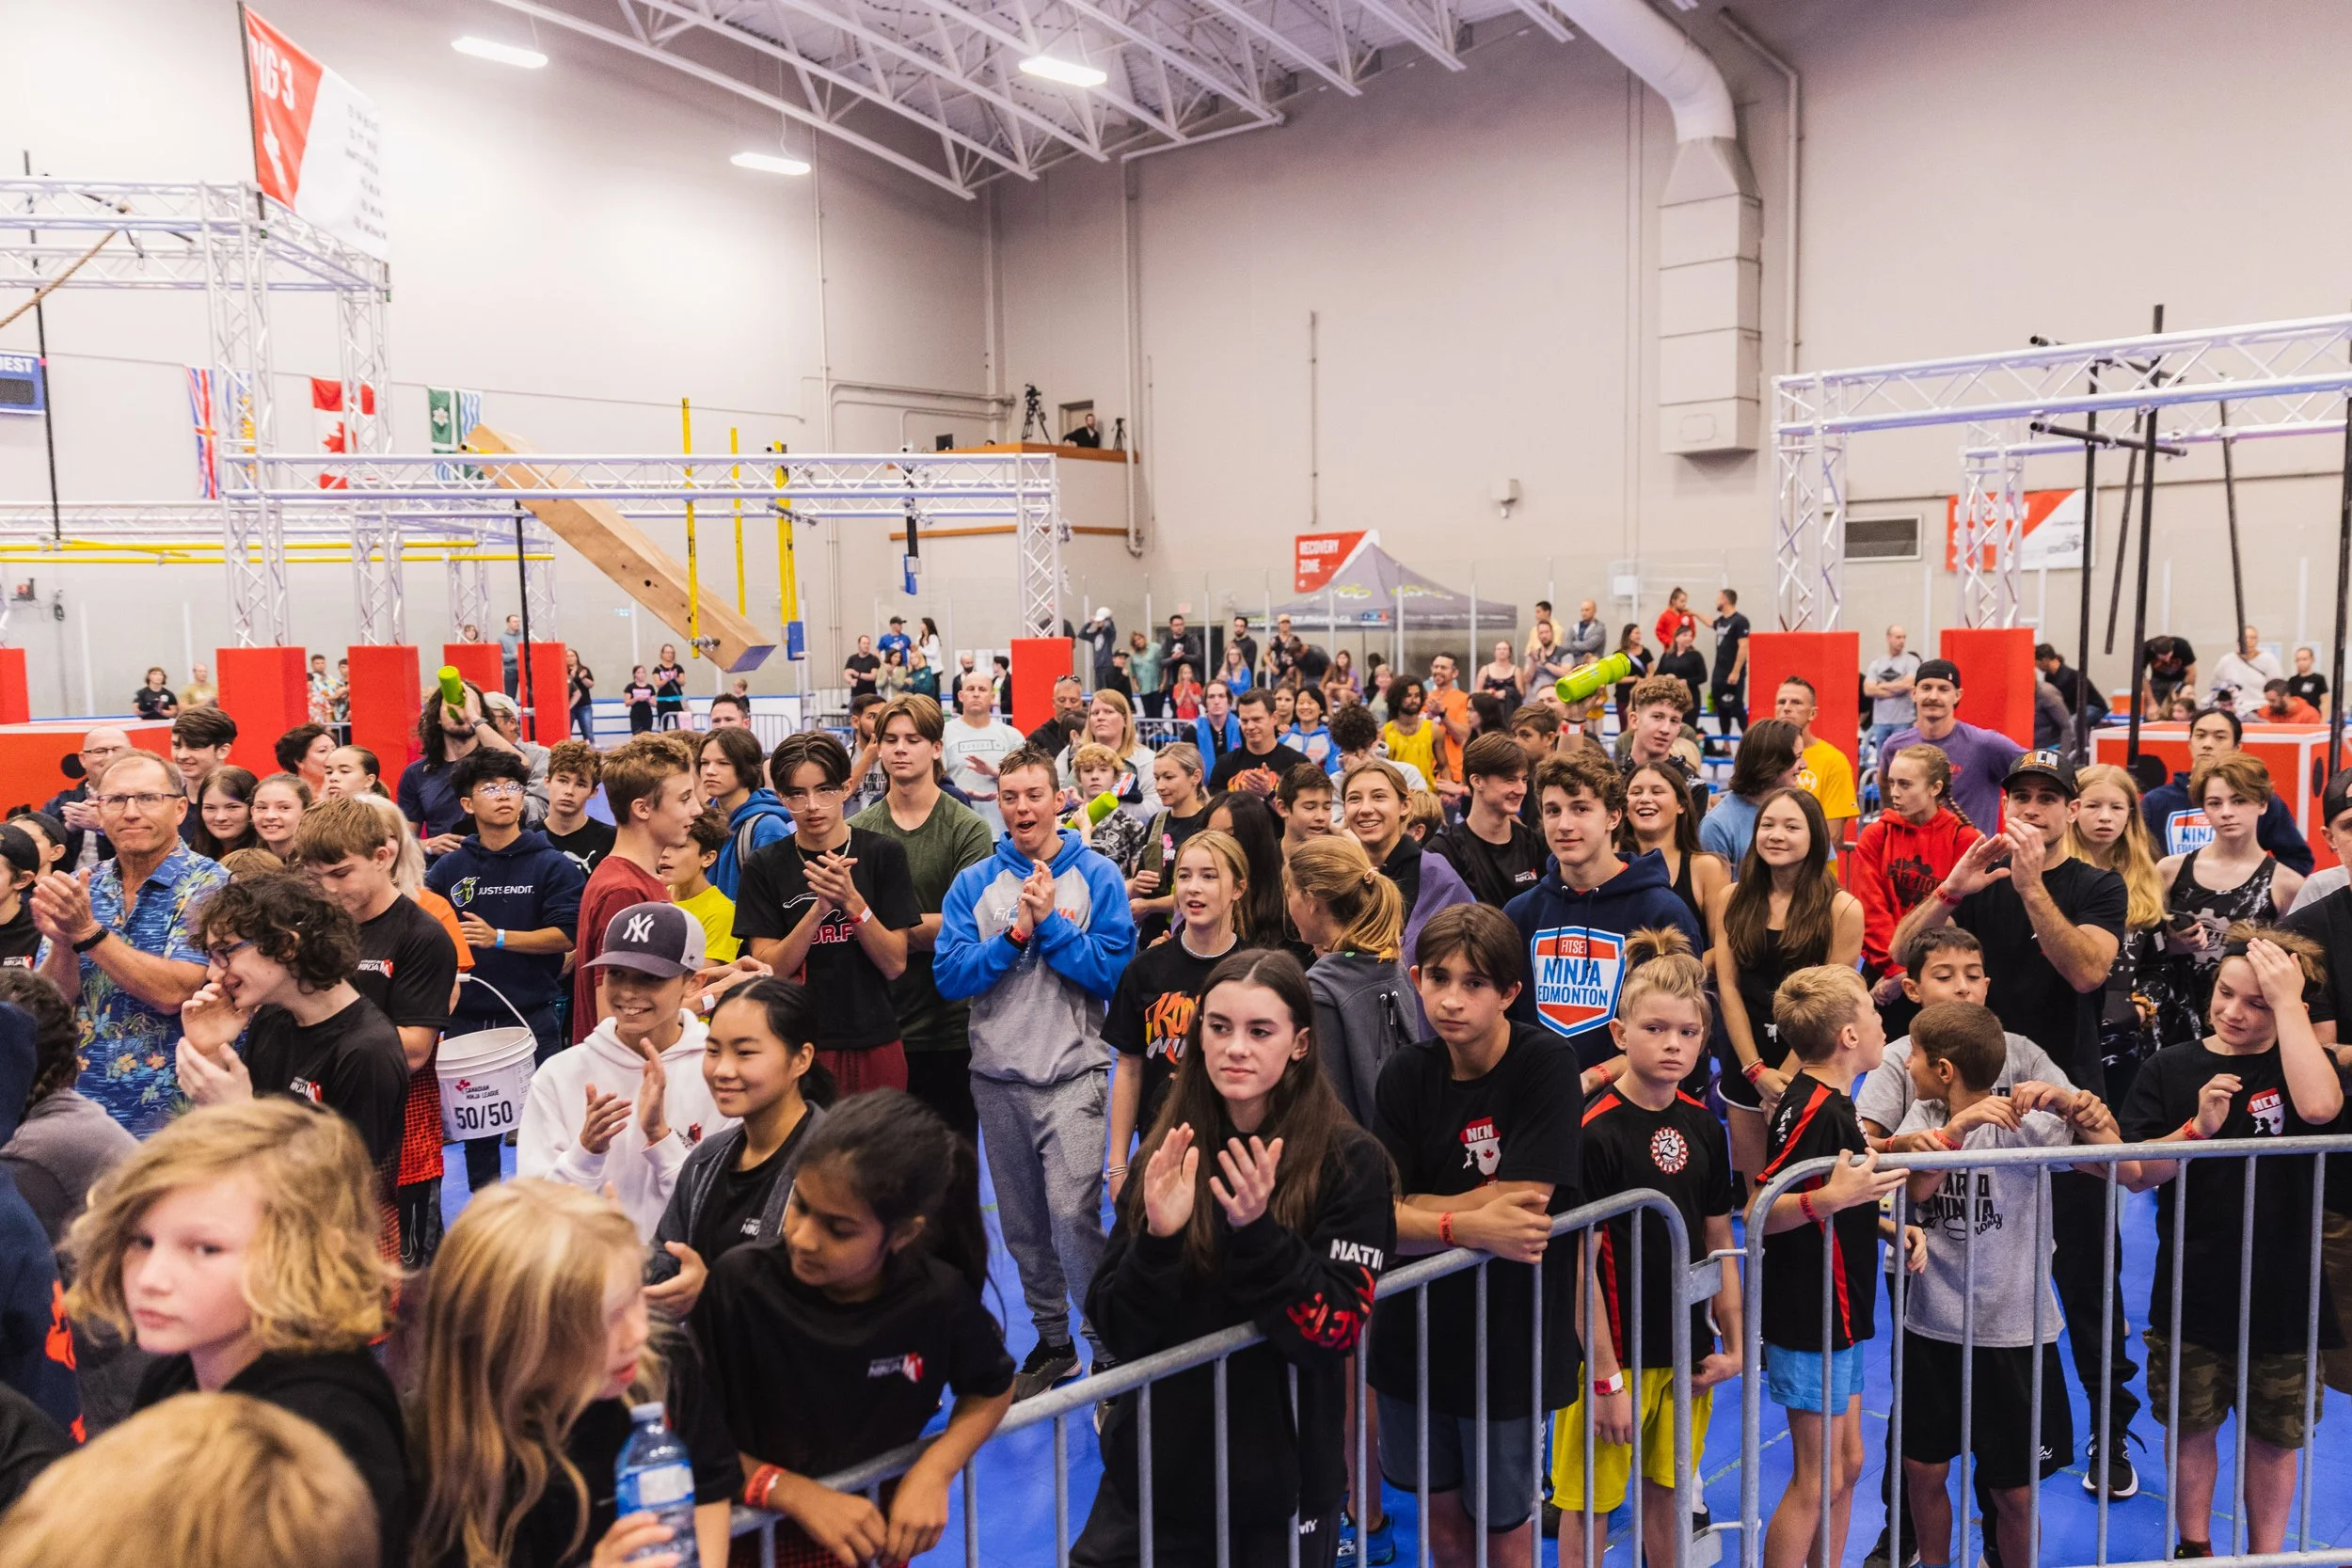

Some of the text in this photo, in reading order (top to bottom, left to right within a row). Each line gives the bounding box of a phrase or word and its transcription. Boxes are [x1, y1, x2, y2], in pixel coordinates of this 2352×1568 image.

[280, 56, 295, 111] 3
[1298, 538, 1341, 555] RECOVERY
[1298, 558, 1321, 574] ZONE
[993, 906, 1013, 922] Fit
[622, 912, 655, 943] NY
[1560, 939, 1588, 955] FITSET
[1543, 958, 1602, 988] NINJA
[1537, 985, 1609, 1006] EDMONTON
[464, 1085, 490, 1094] CANADIAN
[466, 1088, 501, 1101] NINJA LEAGUE
[2251, 1093, 2281, 1113] NCN
[453, 1100, 514, 1131] 50/50
[1466, 1123, 1494, 1143] NCN
[1943, 1212, 2004, 1243] Srong
